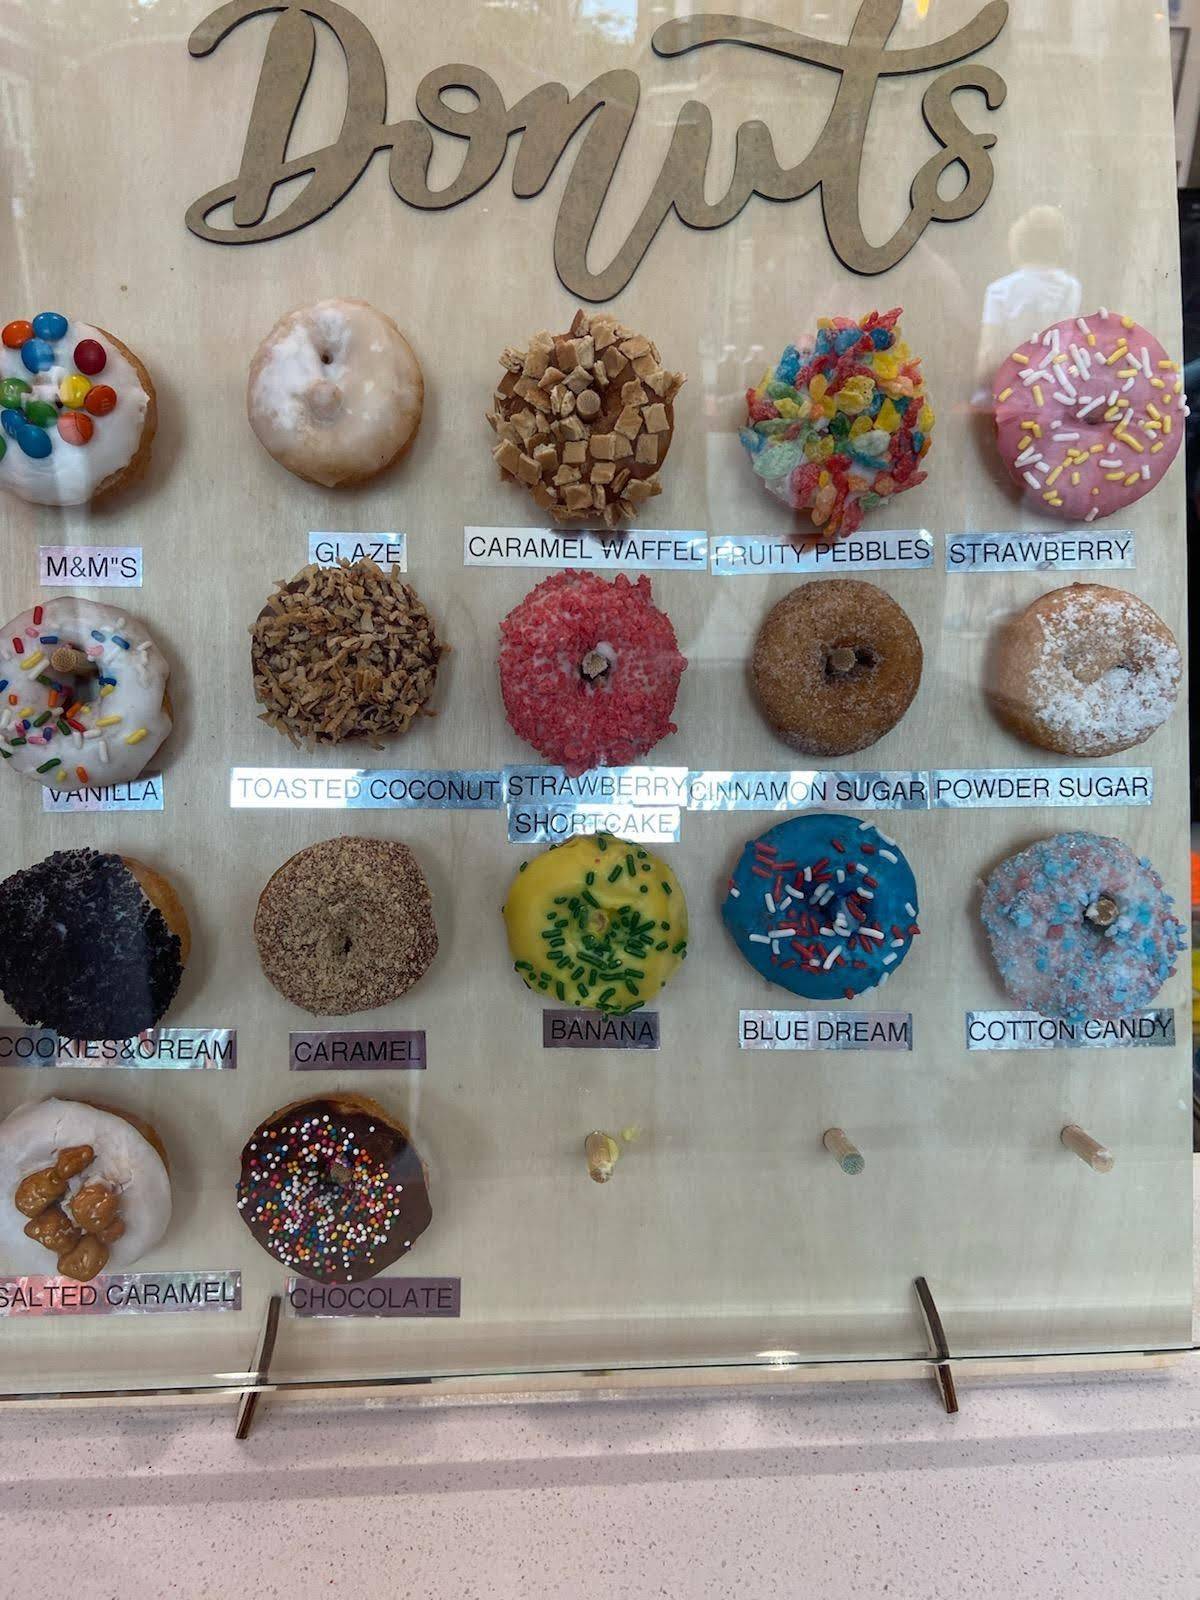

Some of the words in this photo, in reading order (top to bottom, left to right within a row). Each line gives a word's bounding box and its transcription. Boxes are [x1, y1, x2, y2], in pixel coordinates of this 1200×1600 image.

[186, 0, 1009, 303] Donuts
[468, 535, 593, 560] CARAMEL
[601, 538, 703, 562] WAFFEL
[715, 544, 804, 567] FRUITY
[814, 539, 931, 563] PEBBLES
[949, 538, 1131, 565] STRAWBERRY
[46, 556, 138, 579] M&M"S
[49, 780, 159, 803] VANILLA
[237, 776, 362, 802] TOASTED
[369, 779, 500, 802] COCONUT
[508, 775, 687, 798] STRAWBERRY
[689, 779, 826, 803] CINNAMON
[834, 779, 926, 803] SUGAR
[936, 781, 1050, 801] POWDER
[1058, 775, 1149, 799] SUGAR
[515, 812, 674, 834] SHORTCAKE
[550, 1018, 655, 1042] BANANA
[742, 1019, 809, 1042] BLUE
[816, 1020, 909, 1043] DREAM
[969, 1019, 1076, 1041] COTTON
[1083, 1017, 1173, 1040] CANDY
[0, 1036, 234, 1060] COOKIES&CREAM
[293, 1039, 421, 1064] CARAMEL
[0, 1284, 98, 1308] SALTED
[105, 1281, 236, 1306] CARAMEL
[289, 1287, 453, 1310] CHOCOLATE
